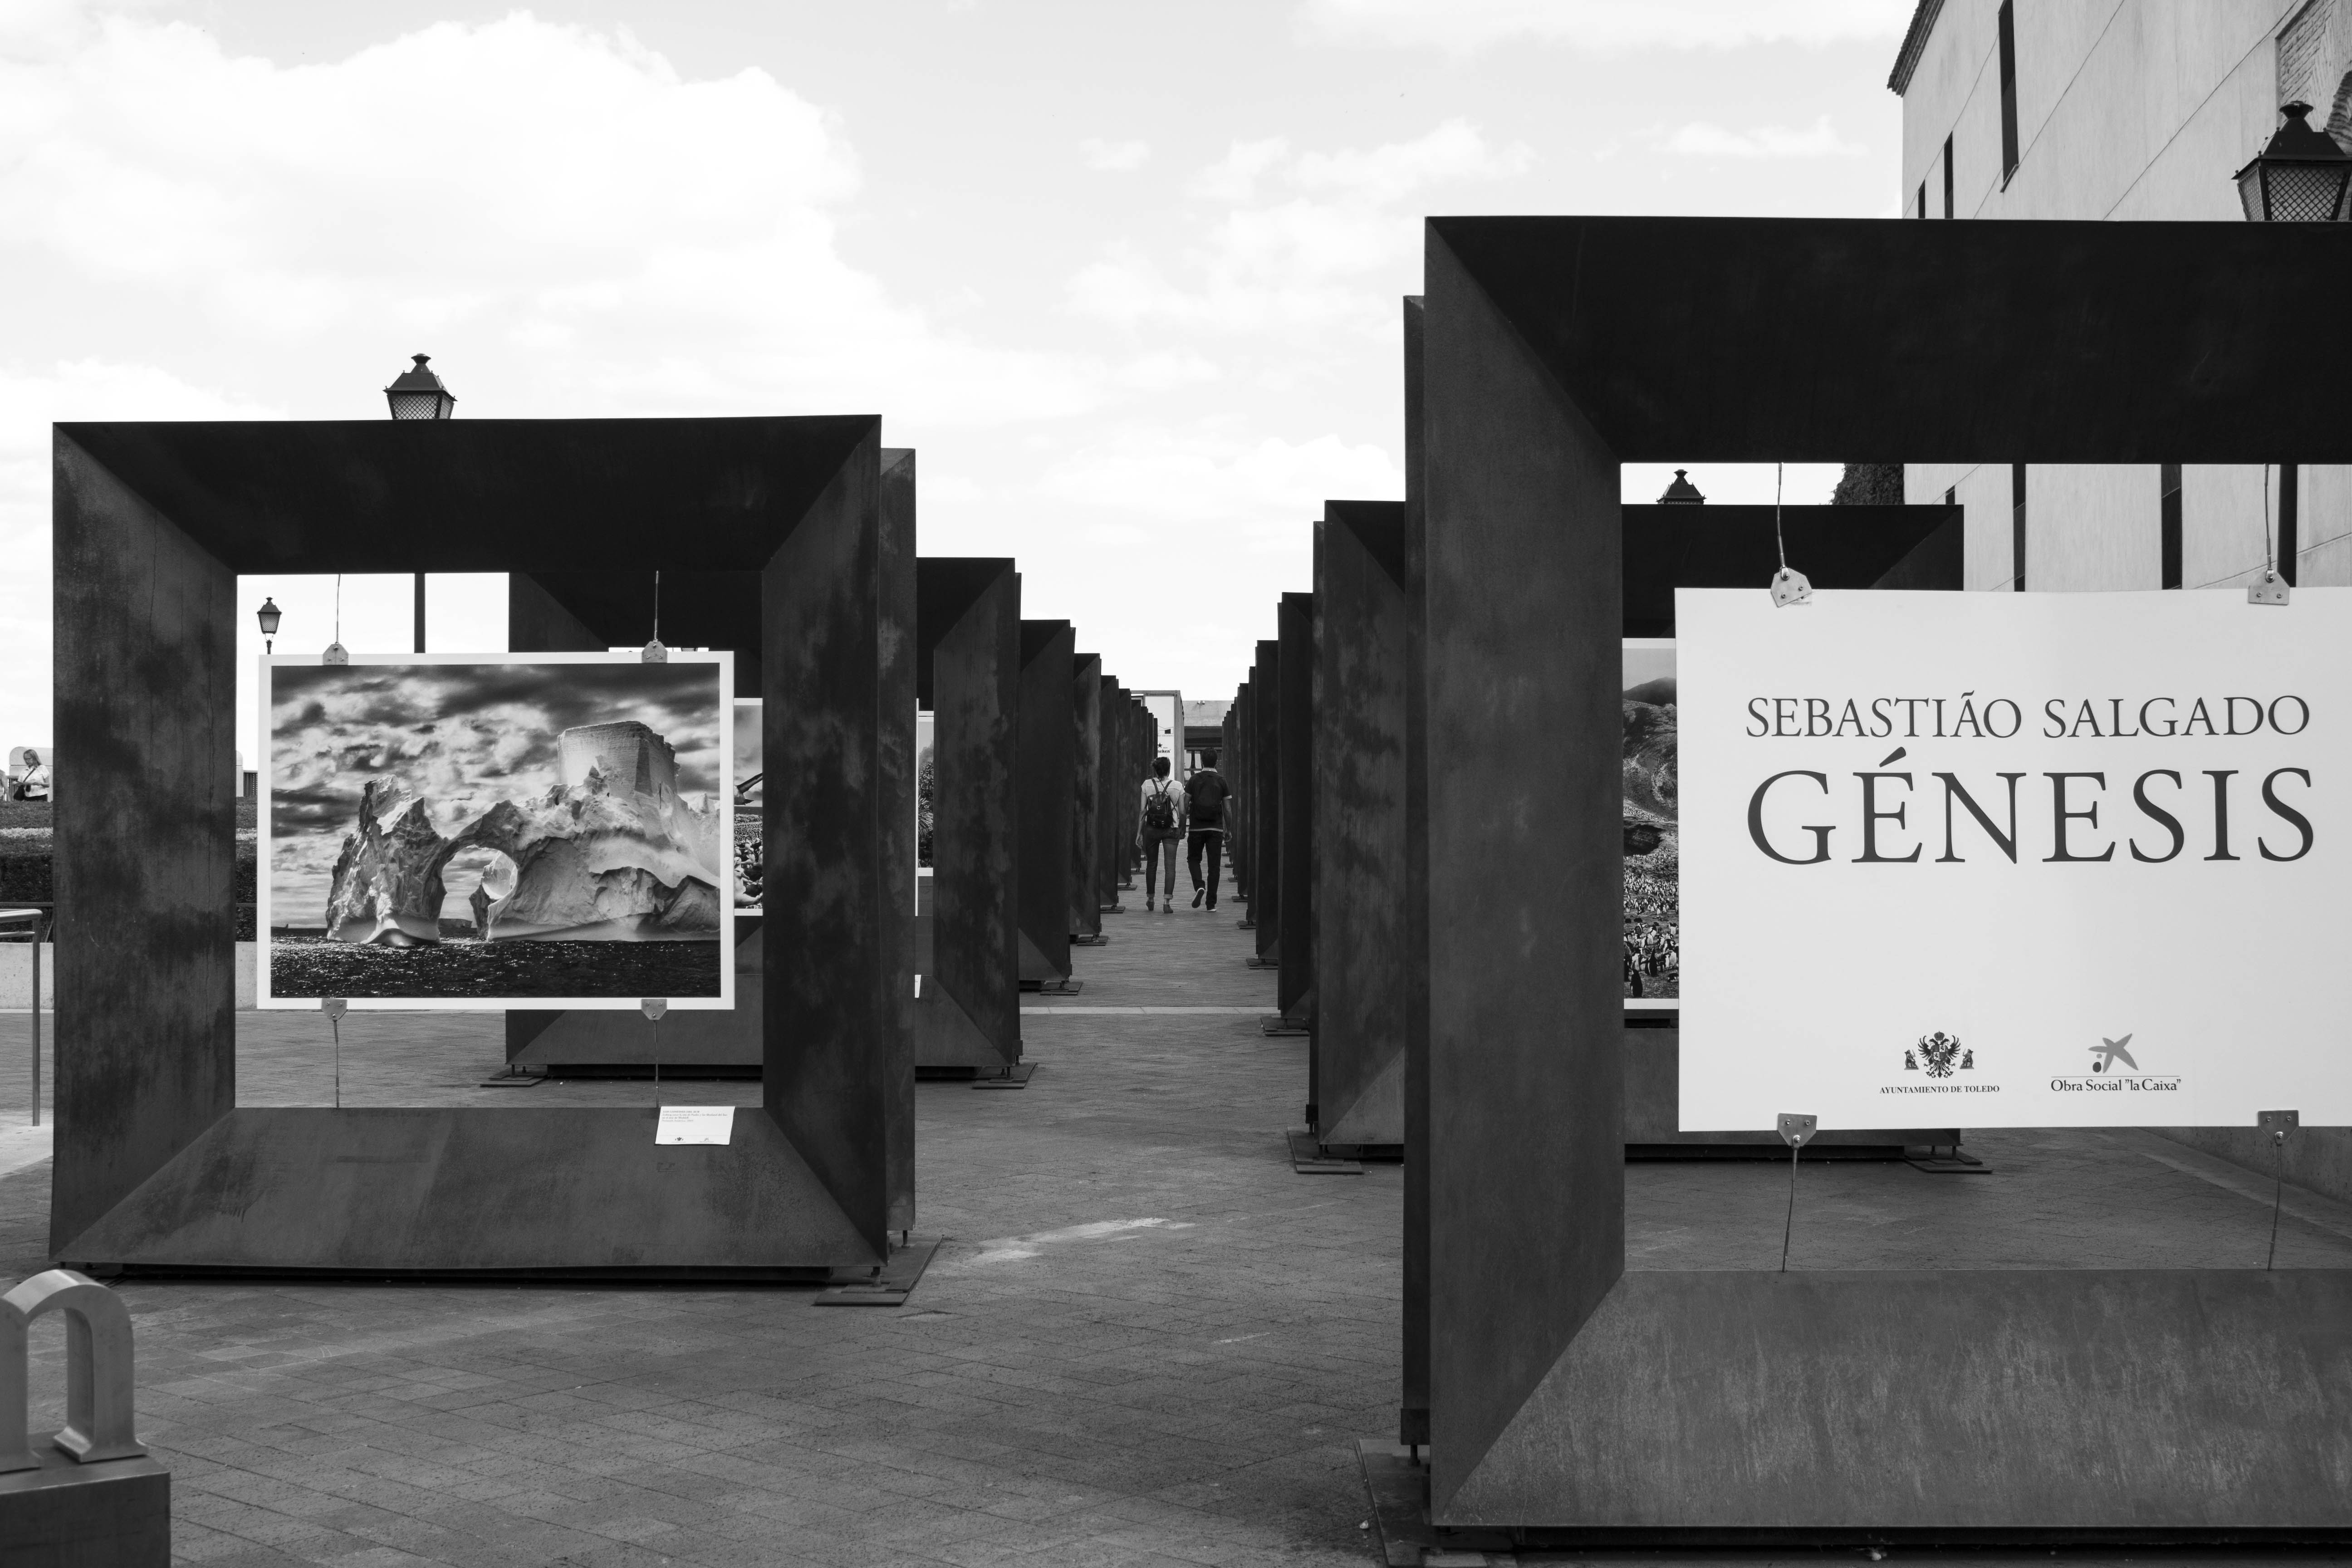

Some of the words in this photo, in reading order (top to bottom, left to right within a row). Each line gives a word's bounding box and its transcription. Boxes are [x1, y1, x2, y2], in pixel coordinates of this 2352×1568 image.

[1747, 691, 2022, 738] SEBASTIÃO
[2043, 695, 2309, 738] SALGADO
[1748, 747, 2314, 865] GÉNESIS
[2051, 1079, 2083, 1092] Obra
[2086, 1079, 2122, 1091] Social
